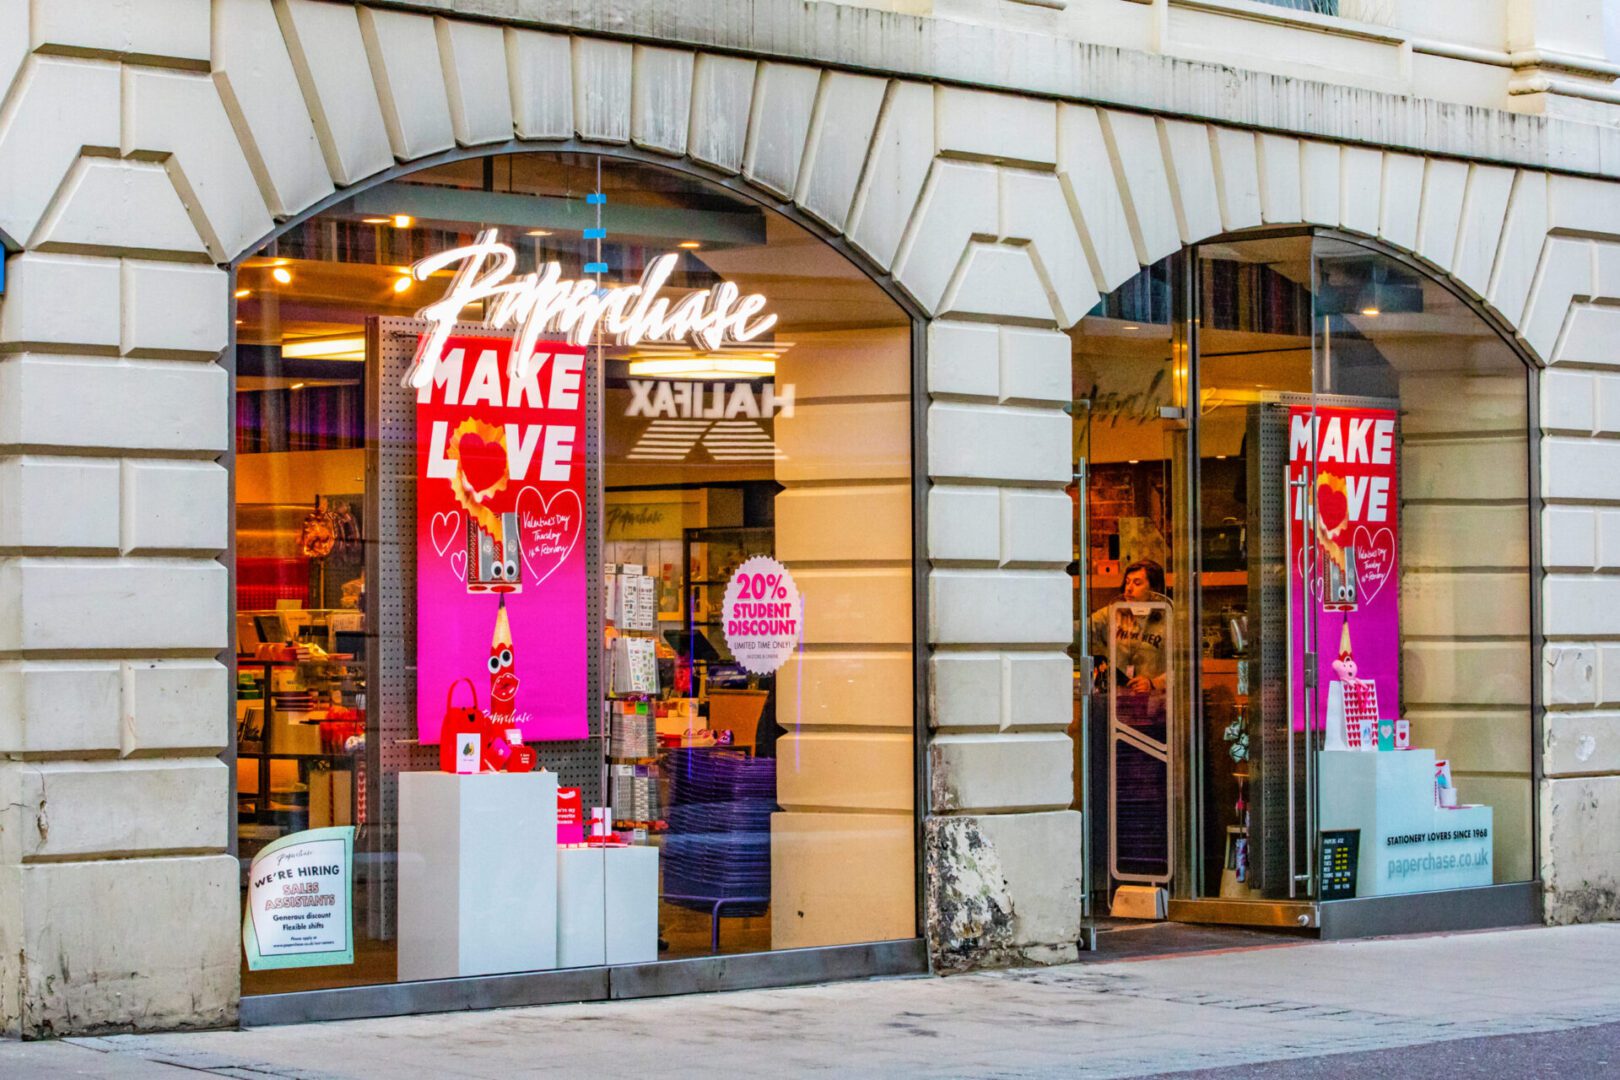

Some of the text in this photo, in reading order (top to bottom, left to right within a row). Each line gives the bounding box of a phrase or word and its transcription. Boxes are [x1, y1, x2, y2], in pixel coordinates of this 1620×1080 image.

[401, 228, 778, 389] Paperchase
[416, 347, 585, 410] MAKE
[1289, 414, 1395, 465] MAKE
[736, 572, 788, 600] 20%
[732, 602, 792, 619] STUDENT
[727, 619, 797, 636] DISCOUNT
[733, 640, 791, 650] LIMITED TIME ONLY!
[1387, 828, 1488, 846] STATIONERY LOVERS SINCE 1968
[1387, 848, 1489, 879] paperchase.co.uk
[254, 864, 340, 889] WE'RE HIRING
[282, 881, 320, 896] SALES
[264, 893, 336, 911] ASSISTANTS
[272, 912, 332, 922] Generous discount
[282, 922, 324, 931] Flexible shifts
